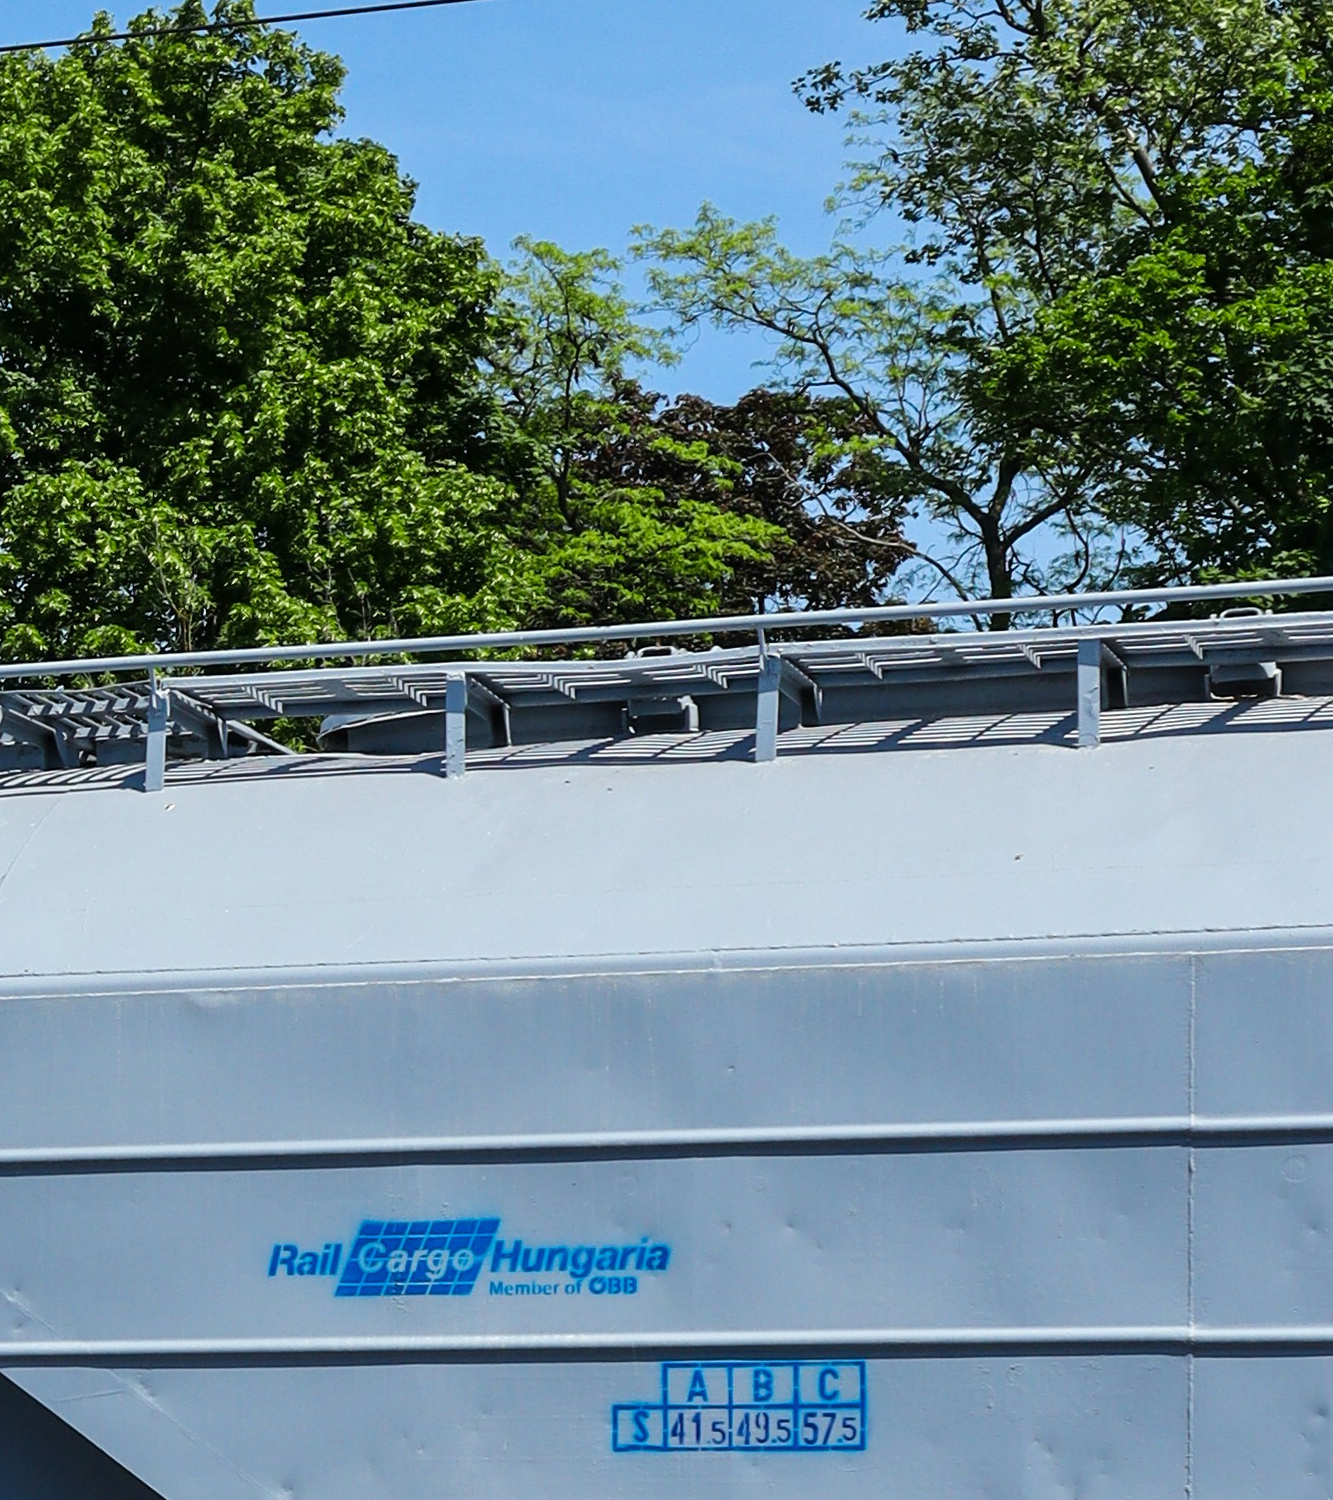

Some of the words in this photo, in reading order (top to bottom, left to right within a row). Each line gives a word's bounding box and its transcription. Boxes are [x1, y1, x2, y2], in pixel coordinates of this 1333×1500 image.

[267, 1243, 343, 1277] Rail
[358, 1241, 475, 1280] Cargo
[490, 1236, 671, 1277] Hungaria
[489, 1280, 561, 1296] Member
[564, 1279, 583, 1295] of
[686, 1369, 709, 1403] A
[752, 1368, 774, 1403] B
[817, 1367, 840, 1401] C
[632, 1410, 650, 1443] S
[670, 1411, 727, 1445] 41.5
[736, 1411, 792, 1445] 49.5
[802, 1411, 858, 1445] 57.5
